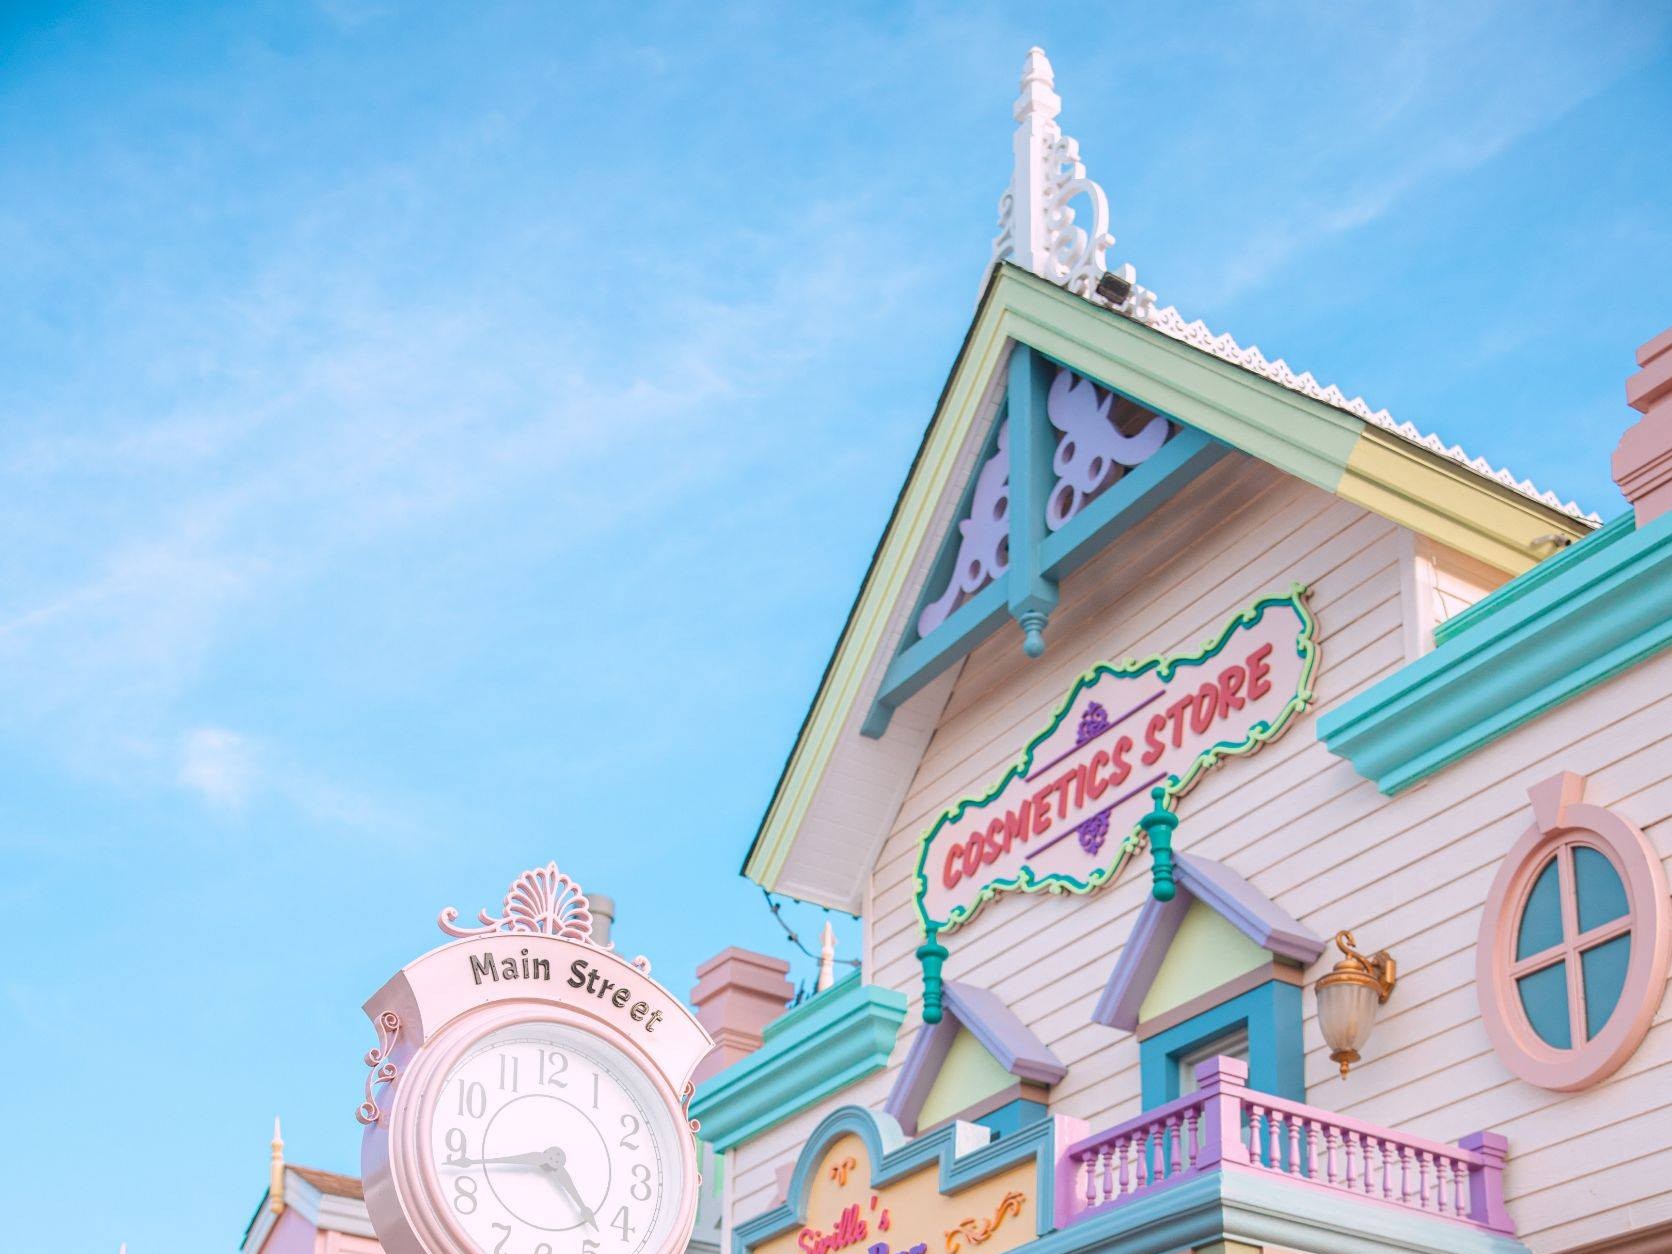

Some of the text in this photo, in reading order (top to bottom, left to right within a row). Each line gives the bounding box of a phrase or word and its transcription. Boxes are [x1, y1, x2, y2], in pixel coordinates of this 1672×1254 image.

[943, 642, 1273, 890] COSMETICS STORE
[469, 948, 665, 1034] Main Street
[498, 1053, 519, 1093] 11
[538, 1048, 569, 1089] 12
[457, 1078, 487, 1119] 10
[592, 1072, 600, 1110] 1
[445, 1127, 468, 1166] 9
[619, 1114, 640, 1151] 2
[453, 1175, 478, 1215] 8
[630, 1163, 652, 1202] 3
[610, 1205, 636, 1243] 4
